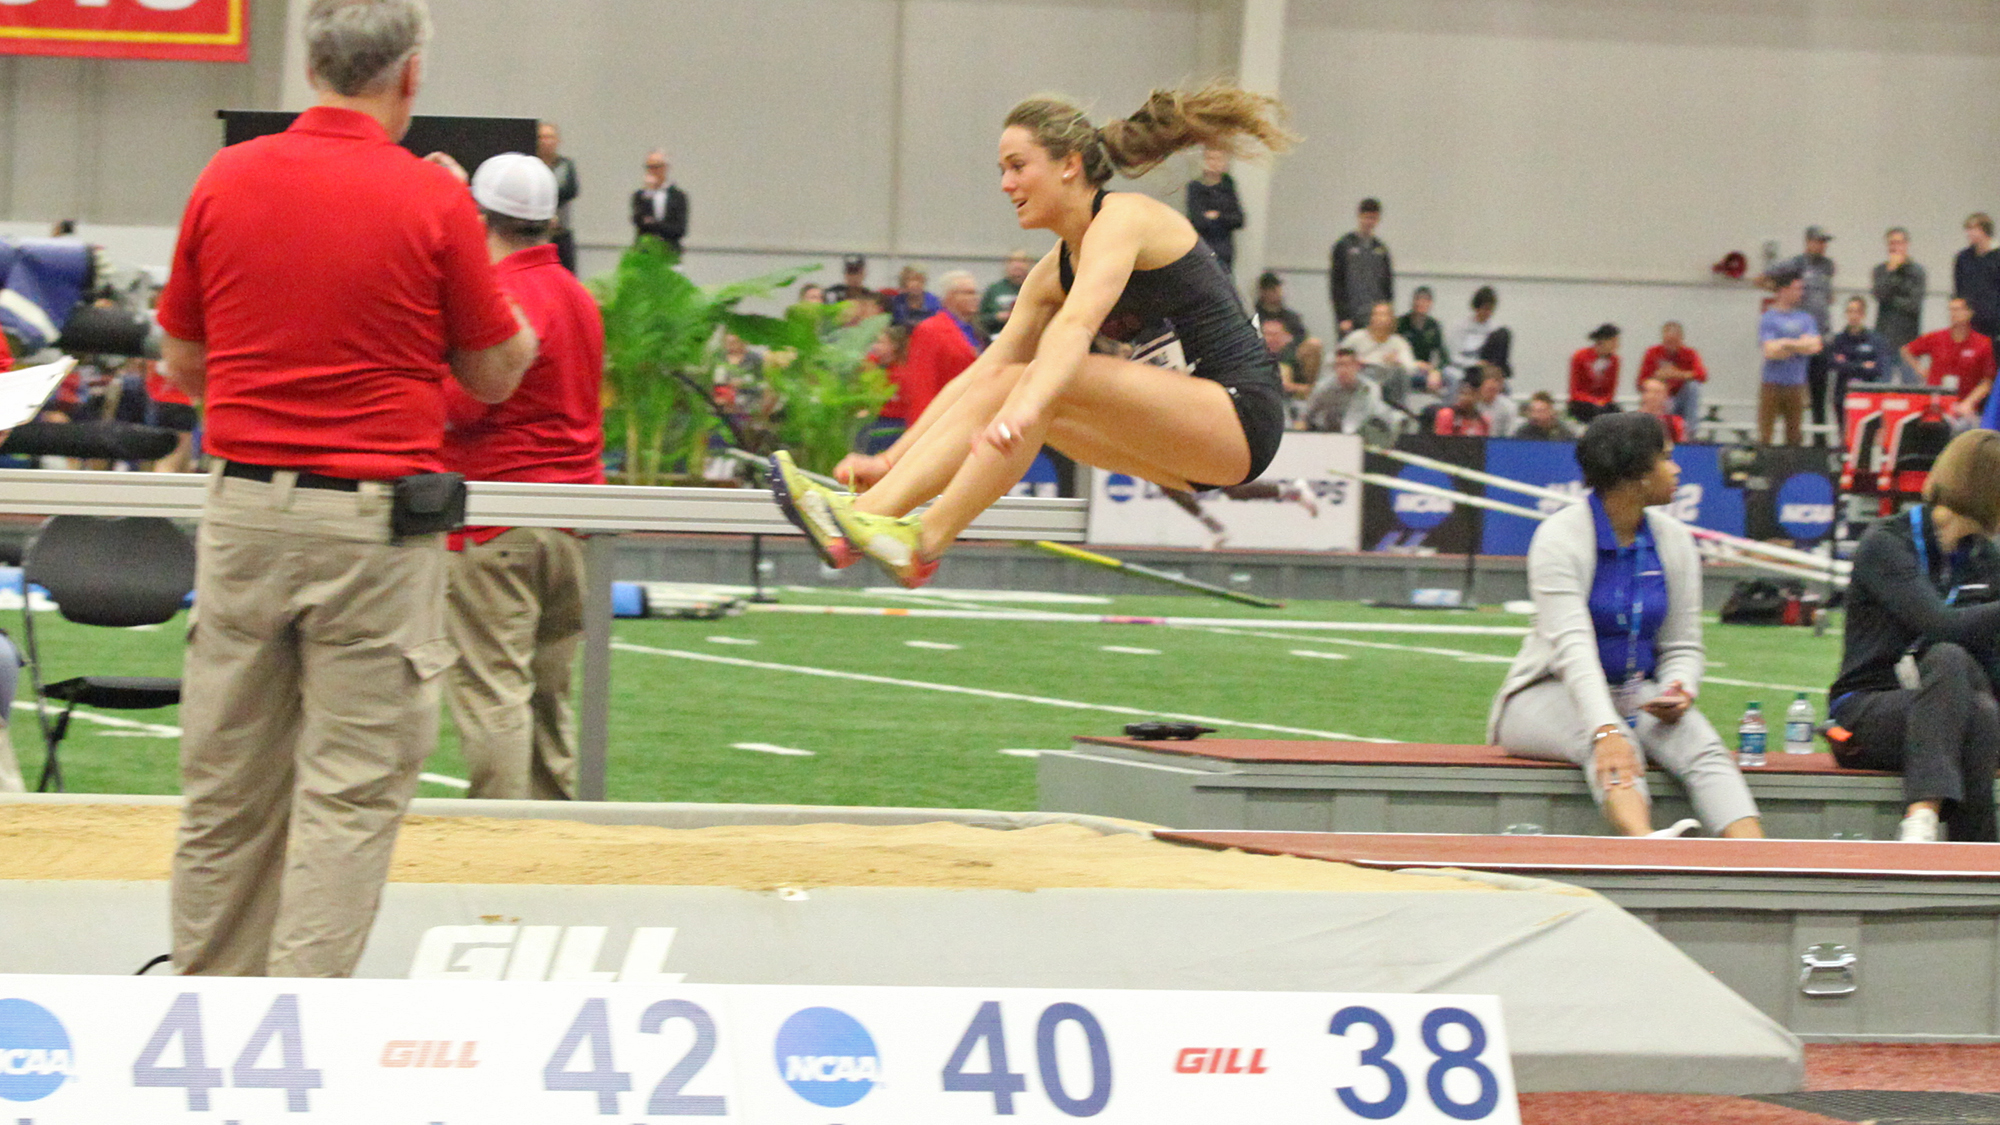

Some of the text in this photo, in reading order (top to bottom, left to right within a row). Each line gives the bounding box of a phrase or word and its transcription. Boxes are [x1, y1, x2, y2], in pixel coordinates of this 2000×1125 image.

[408, 925, 688, 982] GILL
[0, 992, 1499, 1120] CAA 44 GILL 42 NCAA 40 GILL 38
